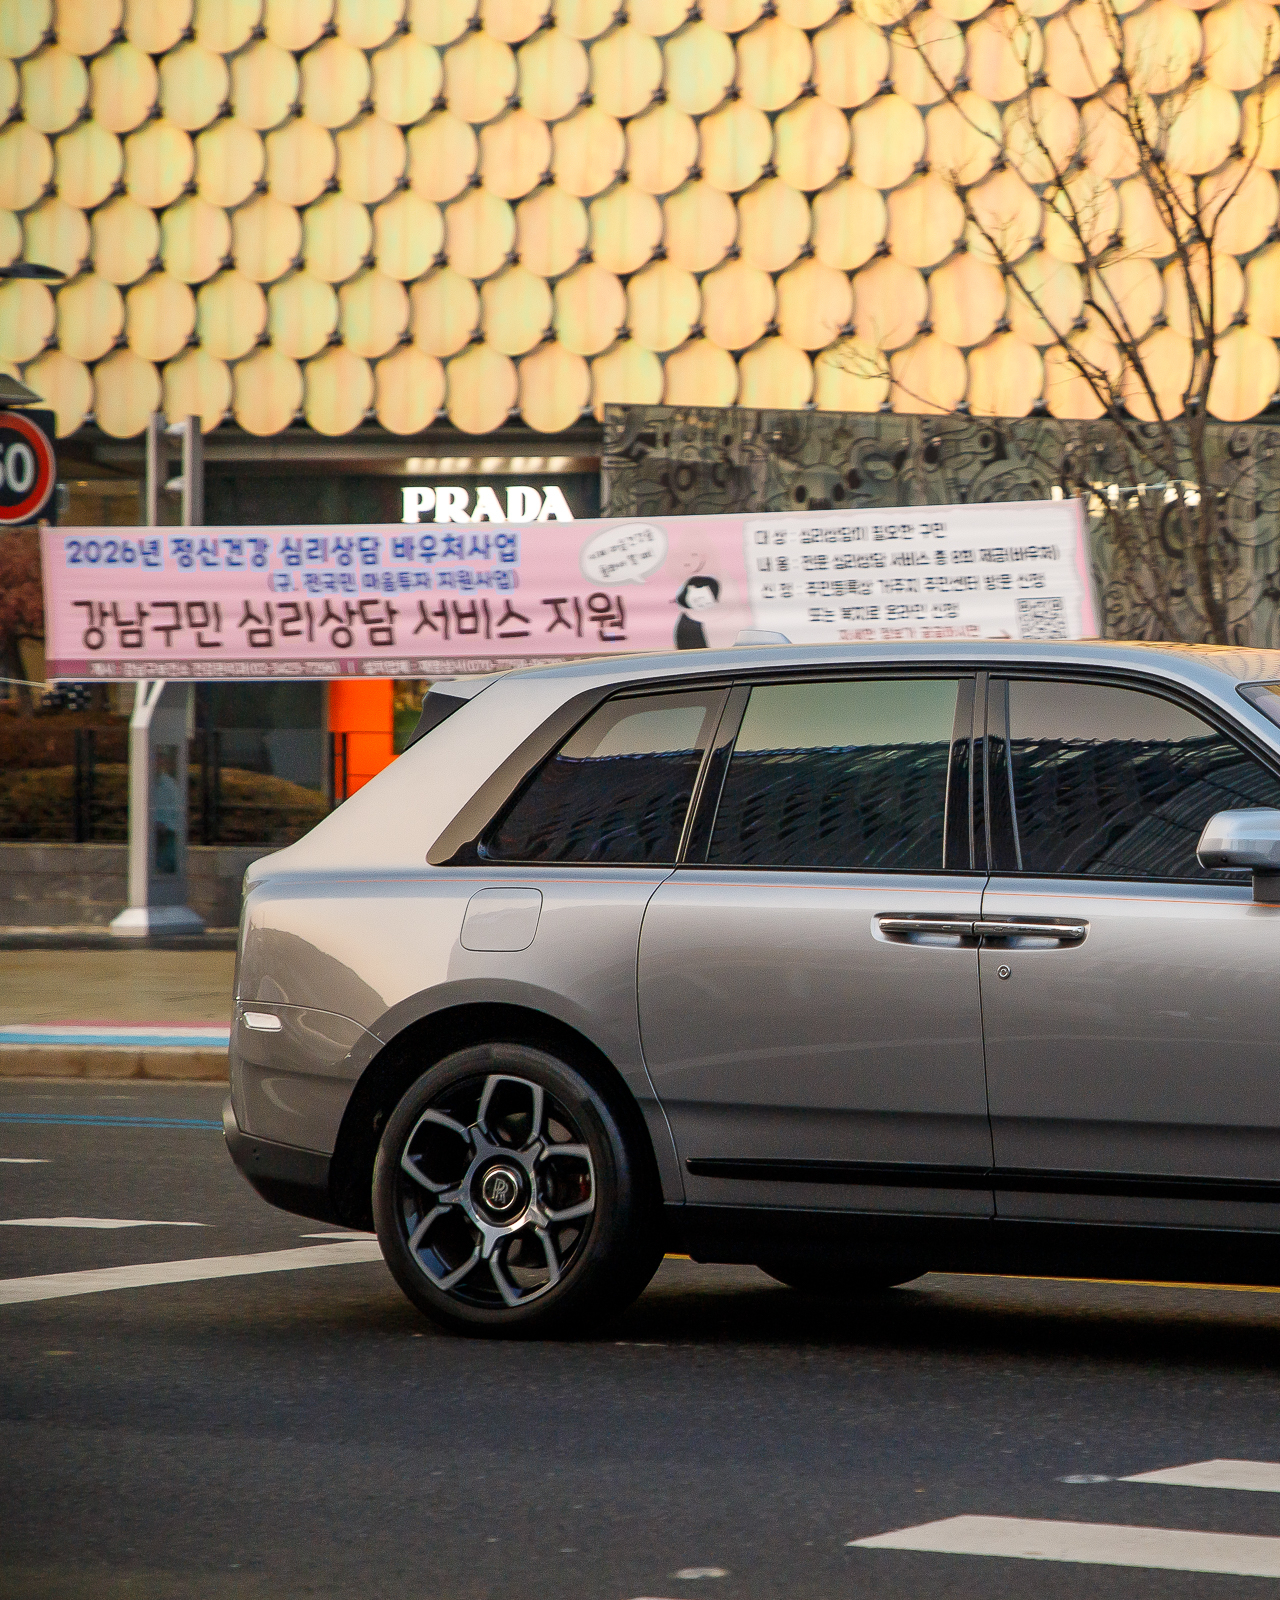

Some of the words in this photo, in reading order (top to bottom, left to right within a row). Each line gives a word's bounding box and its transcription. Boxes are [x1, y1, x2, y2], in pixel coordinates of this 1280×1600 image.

[401, 485, 574, 523] PRADA
[871, 524, 915, 542] 필요한
[918, 522, 948, 540] 구민
[65, 538, 162, 567] 2026년
[170, 537, 271, 568] 정신건강
[279, 535, 381, 567] 심리상담
[389, 532, 518, 564] 바우처사업
[801, 554, 830, 571] 전문
[832, 551, 887, 569] 심리상담
[889, 550, 931, 566] 서비스
[934, 549, 948, 566] 총
[979, 544, 1060, 564] 제공(바우처)
[303, 571, 358, 594] 전국민
[363, 570, 432, 593] 마음투자
[437, 569, 520, 592] 지원사업)
[805, 578, 874, 597] 주민등록상
[876, 577, 920, 594] 거주지
[923, 575, 979, 593] 주민센터
[982, 573, 1013, 591] 방문
[1017, 572, 1046, 589] 신청
[72, 599, 223, 650] 강남구민
[238, 598, 399, 649] 심리상담
[413, 597, 531, 641] 서비스
[541, 591, 628, 642] 지원
[807, 607, 836, 623] 또는
[840, 604, 881, 621] 복지로
[884, 603, 927, 621] 온라인
[930, 602, 961, 620] 신청
